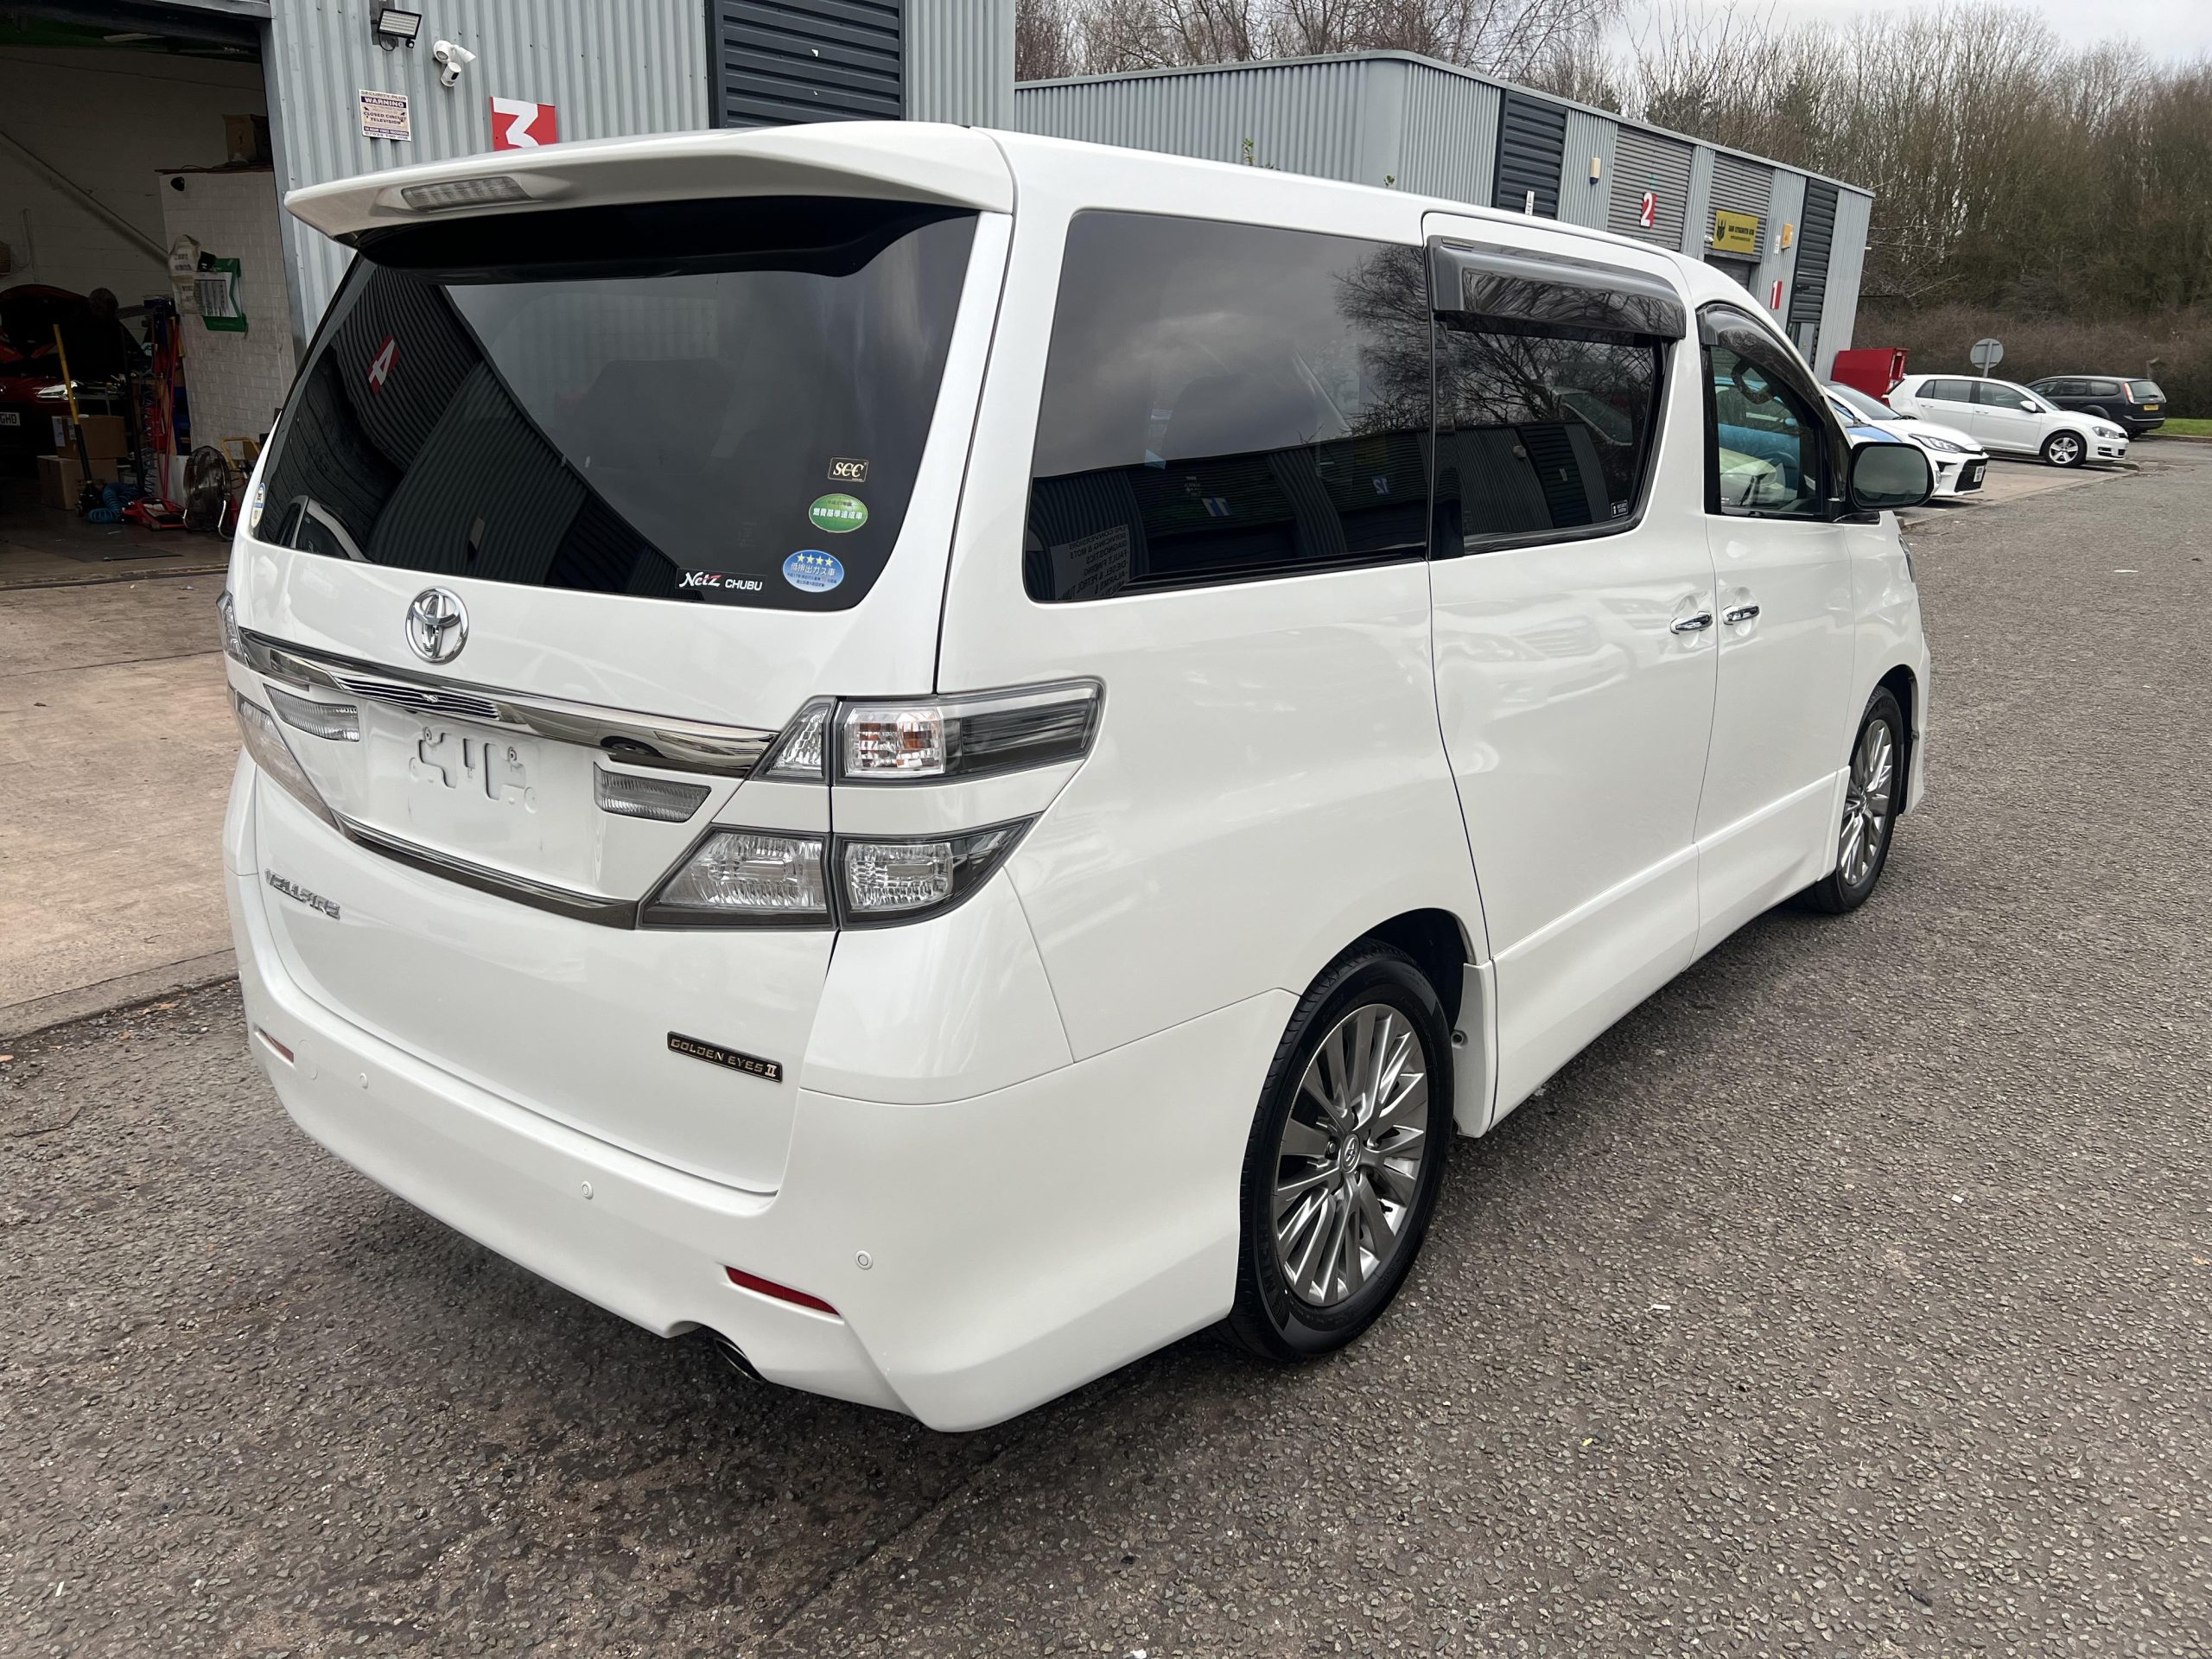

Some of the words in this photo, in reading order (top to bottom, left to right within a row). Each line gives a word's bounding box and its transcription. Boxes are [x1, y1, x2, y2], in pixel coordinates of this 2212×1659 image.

[365, 97, 404, 107] WARNING
[493, 97, 539, 148] 3
[1640, 192, 1653, 227] 2
[678, 571, 722, 588] Netz
[725, 579, 763, 591] CHUBU
[671, 1038, 725, 1061] GOLDEN
[728, 1056, 764, 1072] EYES
